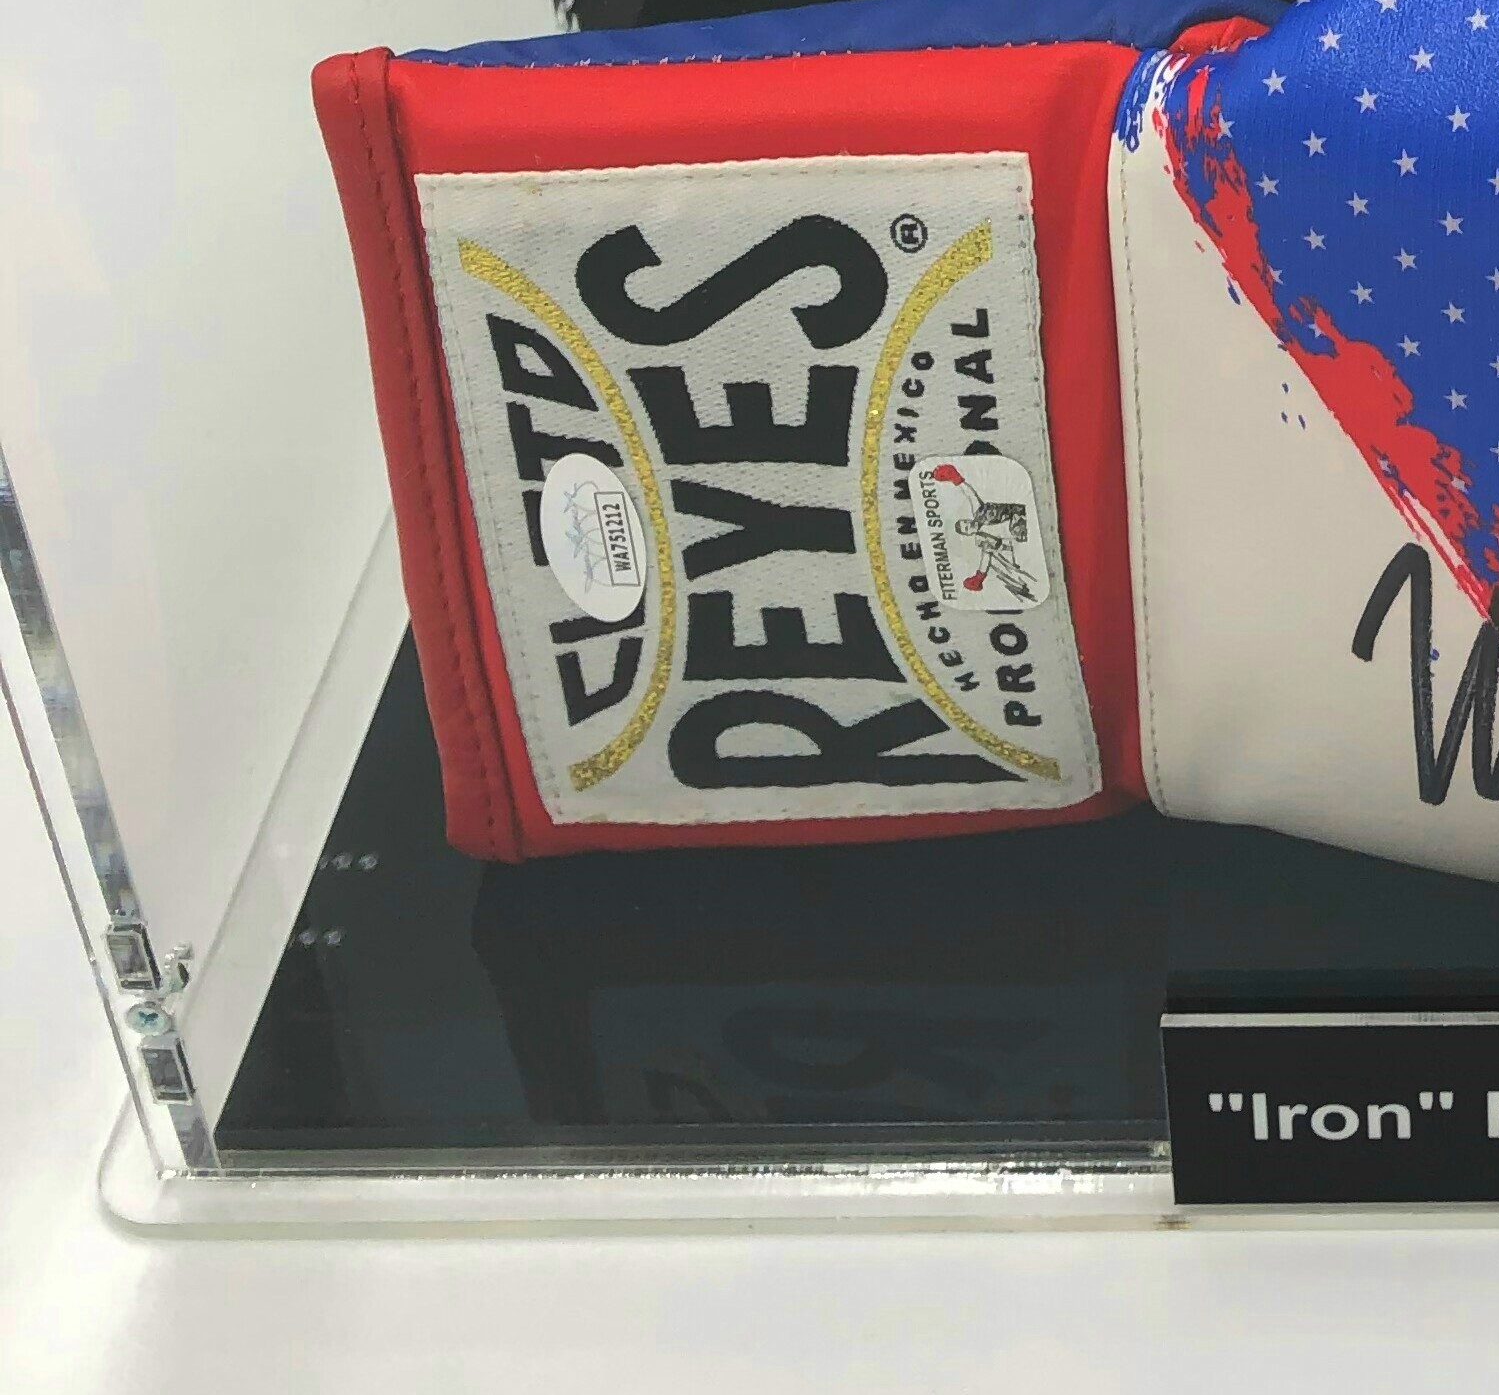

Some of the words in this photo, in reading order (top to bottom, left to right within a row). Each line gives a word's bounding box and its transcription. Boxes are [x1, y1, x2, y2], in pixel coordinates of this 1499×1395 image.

[575, 213, 1028, 789] REYES
[920, 470, 939, 528] SPORTS
[602, 503, 632, 572] WA751212
[897, 517, 922, 561] EN
[928, 531, 957, 601] FITERMAN
[1208, 1091, 1453, 1140] "Iron"
